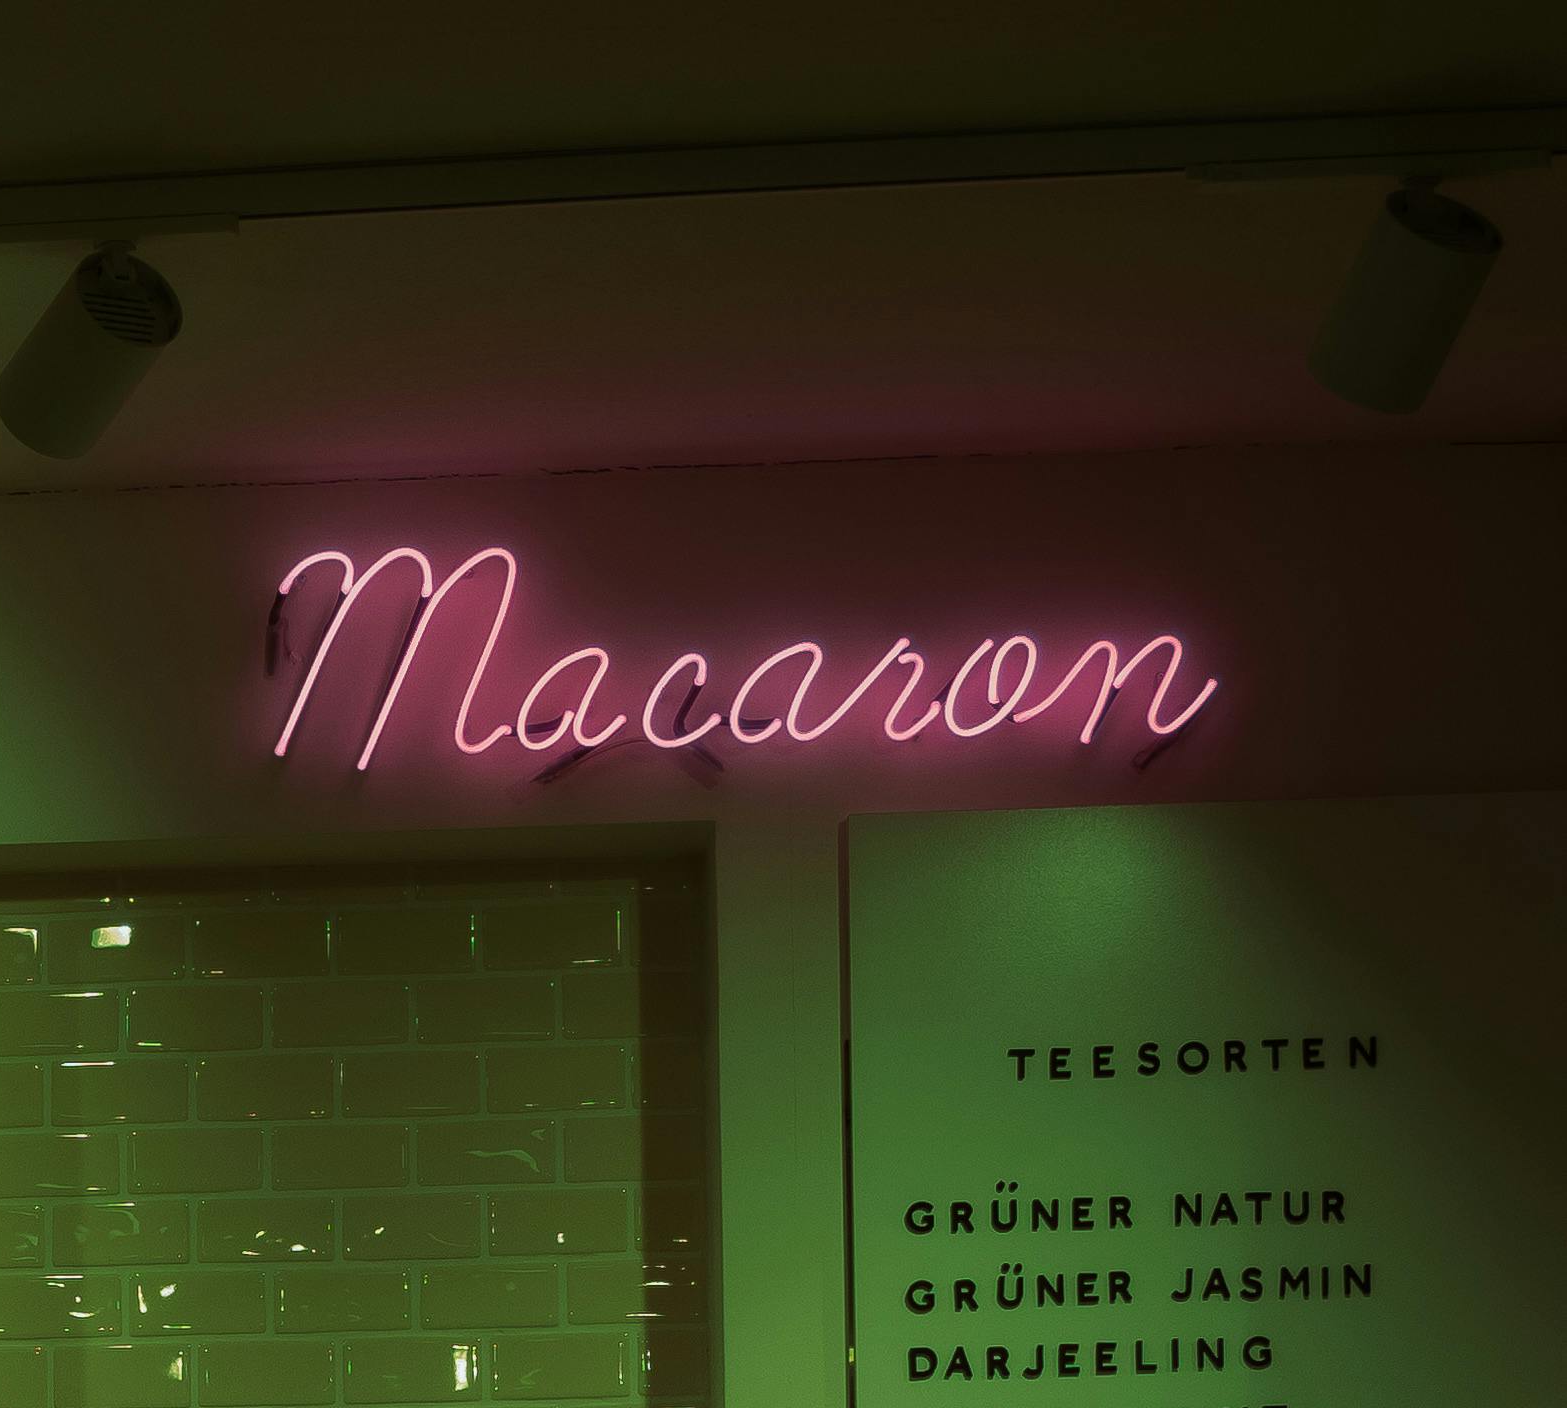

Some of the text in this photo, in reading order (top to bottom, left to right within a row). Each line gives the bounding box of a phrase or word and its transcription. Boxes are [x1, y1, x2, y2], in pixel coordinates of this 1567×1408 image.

[275, 547, 1217, 769] Macaron
[1008, 1036, 1380, 1082] TEESORTEN
[904, 1180, 1347, 1235] GRÜNER NATUR
[904, 1263, 1374, 1314] GRÜNER JASMIN
[907, 1336, 1273, 1382] DARJEELING
